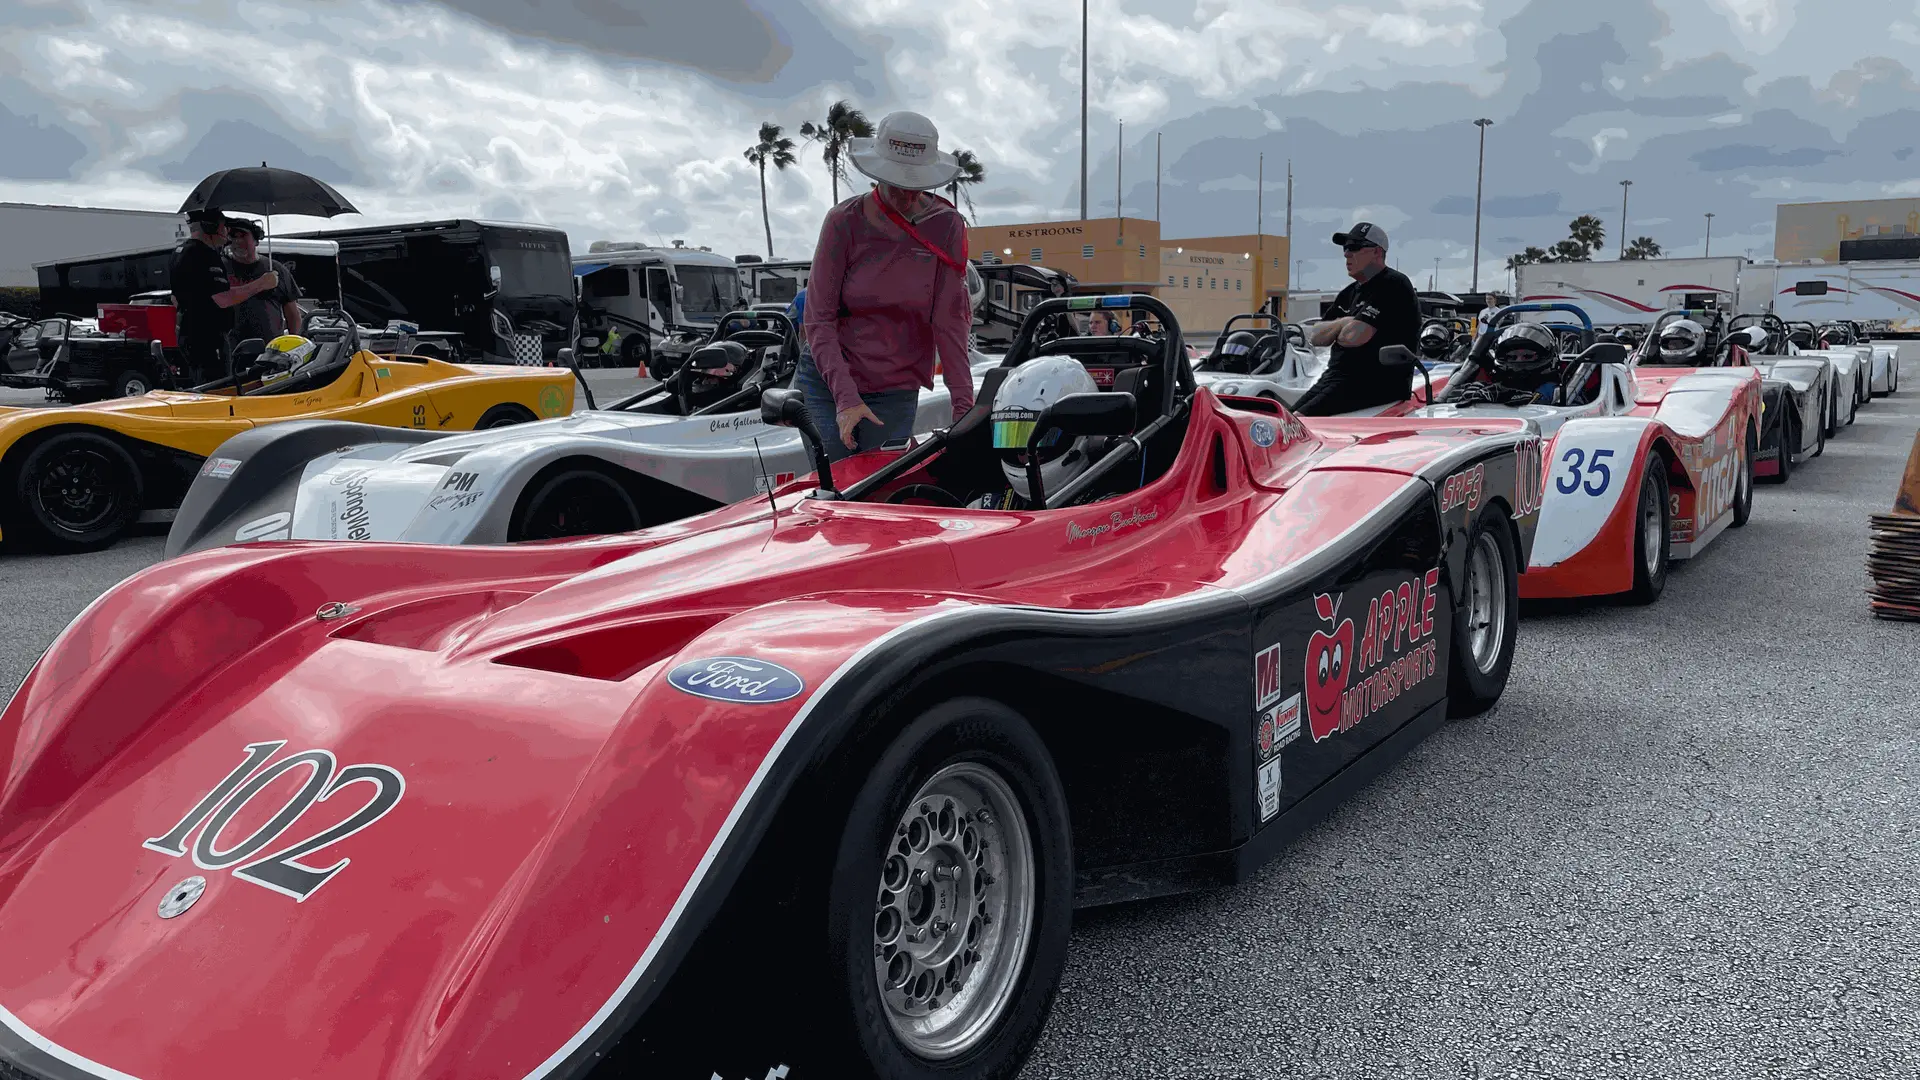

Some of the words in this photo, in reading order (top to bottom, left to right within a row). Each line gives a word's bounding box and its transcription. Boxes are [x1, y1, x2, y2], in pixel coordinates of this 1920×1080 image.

[1009, 226, 1083, 238] RESTROOMS
[1189, 256, 1225, 265] RESTROOMS
[710, 420, 730, 432] Chad
[1256, 423, 1272, 442] Ford
[442, 472, 480, 491] PM
[1556, 447, 1615, 497] 35
[1442, 462, 1485, 514] SRF3
[1065, 520, 1110, 547] Morgan
[1359, 567, 1439, 673] APPLE
[687, 660, 778, 696] Ford
[1340, 638, 1436, 734] MOTORSPORTS
[142, 739, 405, 903] 102
